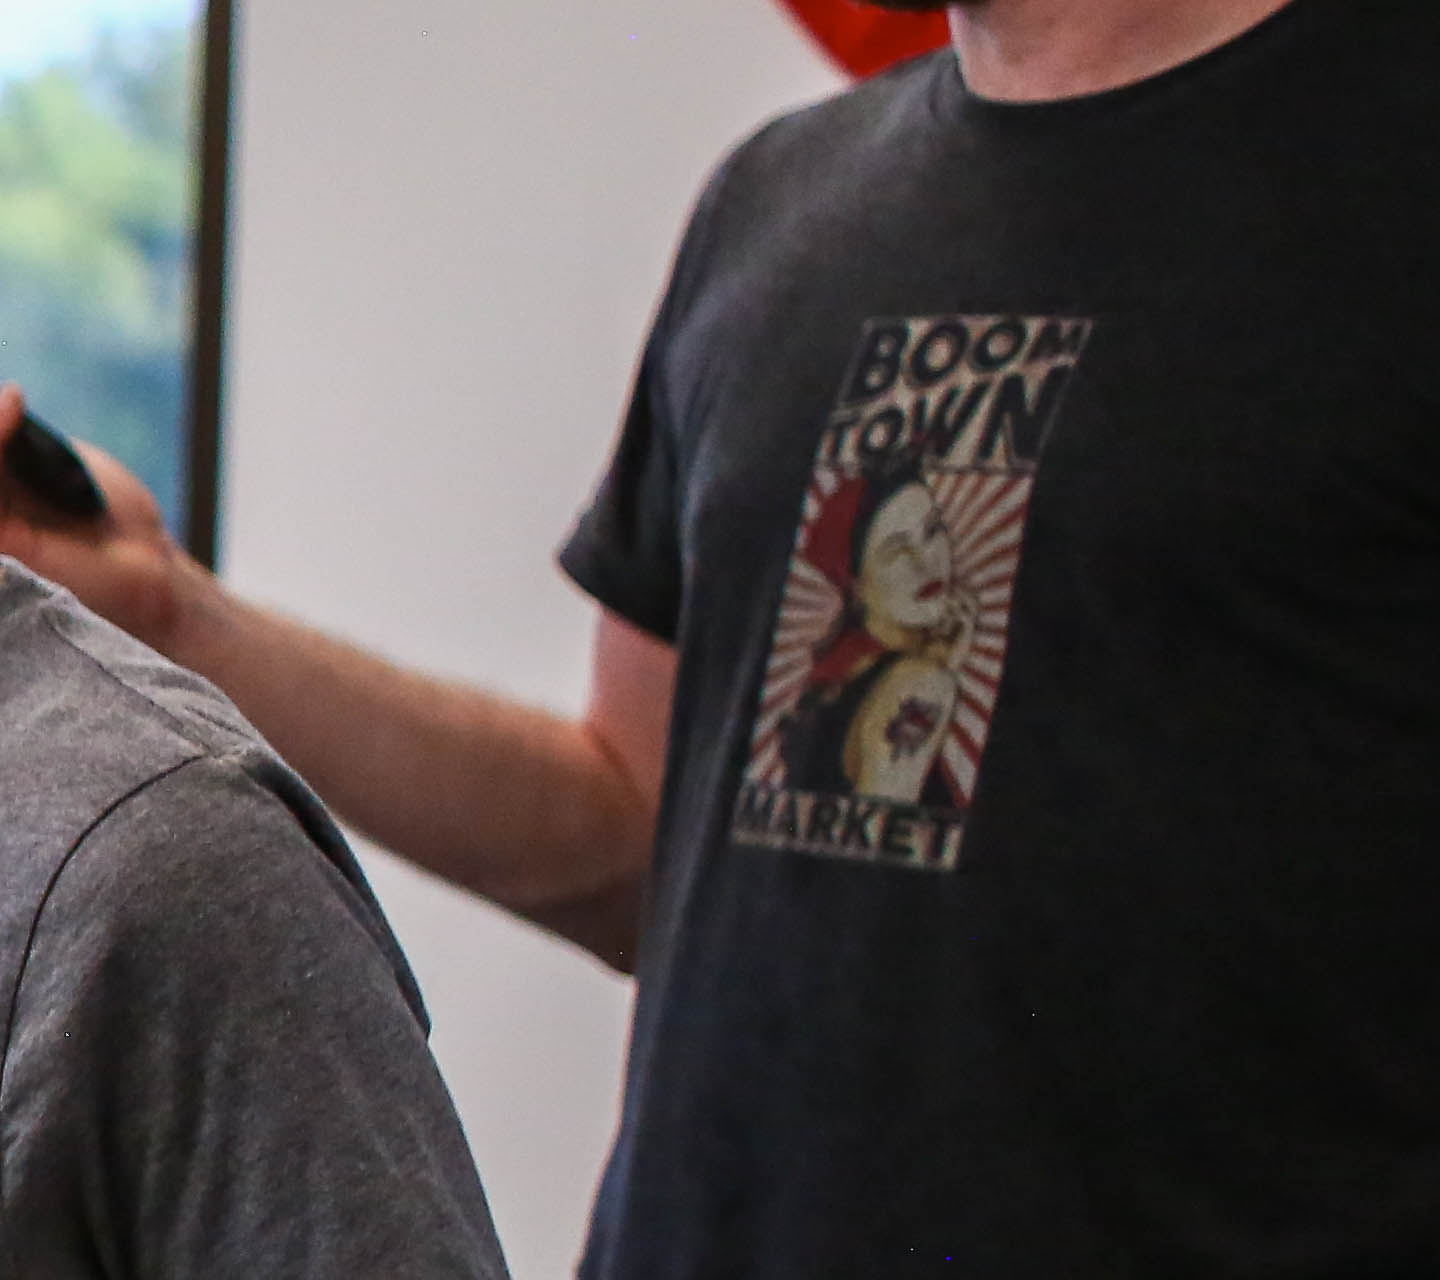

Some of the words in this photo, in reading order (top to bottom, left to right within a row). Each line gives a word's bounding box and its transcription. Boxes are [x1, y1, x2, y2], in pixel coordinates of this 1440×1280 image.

[846, 320, 1082, 402] BOOM
[822, 365, 1076, 467] TOWN
[736, 786, 964, 863] MARKET
